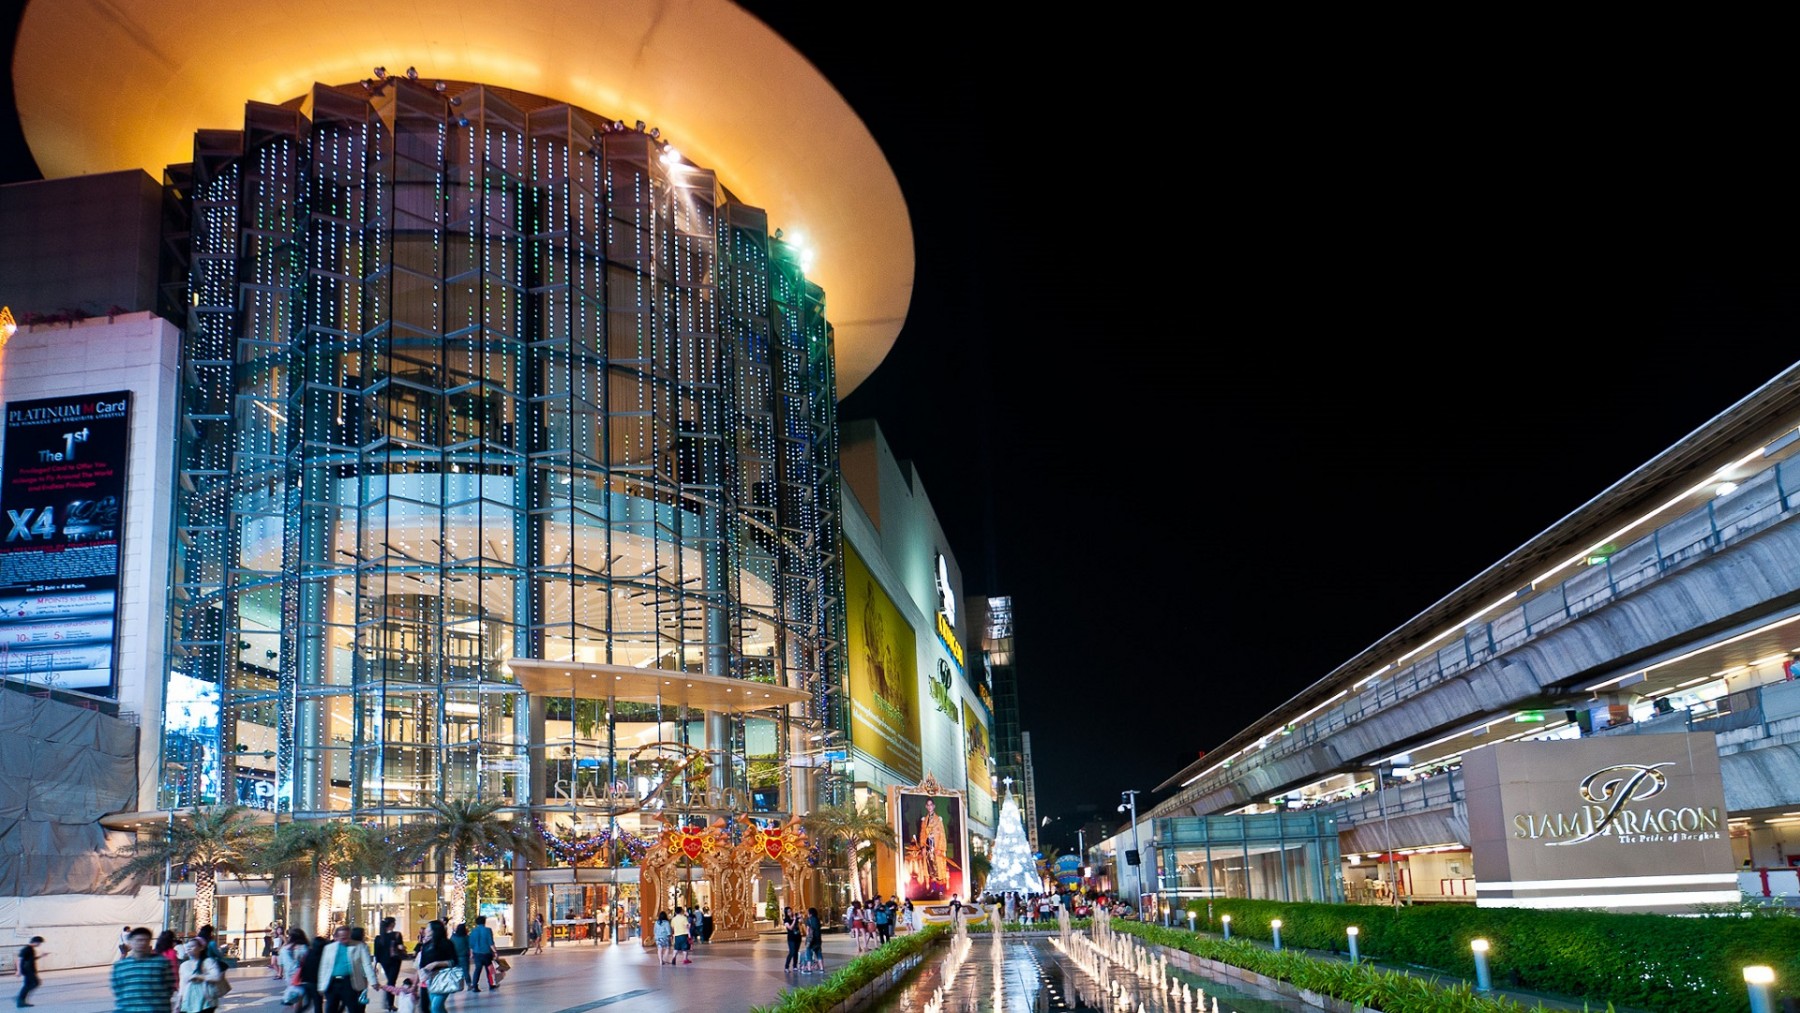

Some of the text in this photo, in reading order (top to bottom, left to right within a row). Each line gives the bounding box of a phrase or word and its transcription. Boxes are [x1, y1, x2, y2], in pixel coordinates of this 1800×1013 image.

[9, 404, 80, 422] PLATINUM
[96, 399, 126, 414] Card
[39, 427, 90, 462] The 1st
[6, 506, 56, 542] X4
[554, 779, 626, 808] SIAM
[1513, 805, 1720, 839] SIAM PARAGON
[1619, 831, 1720, 843] The Pride of Bangkok
